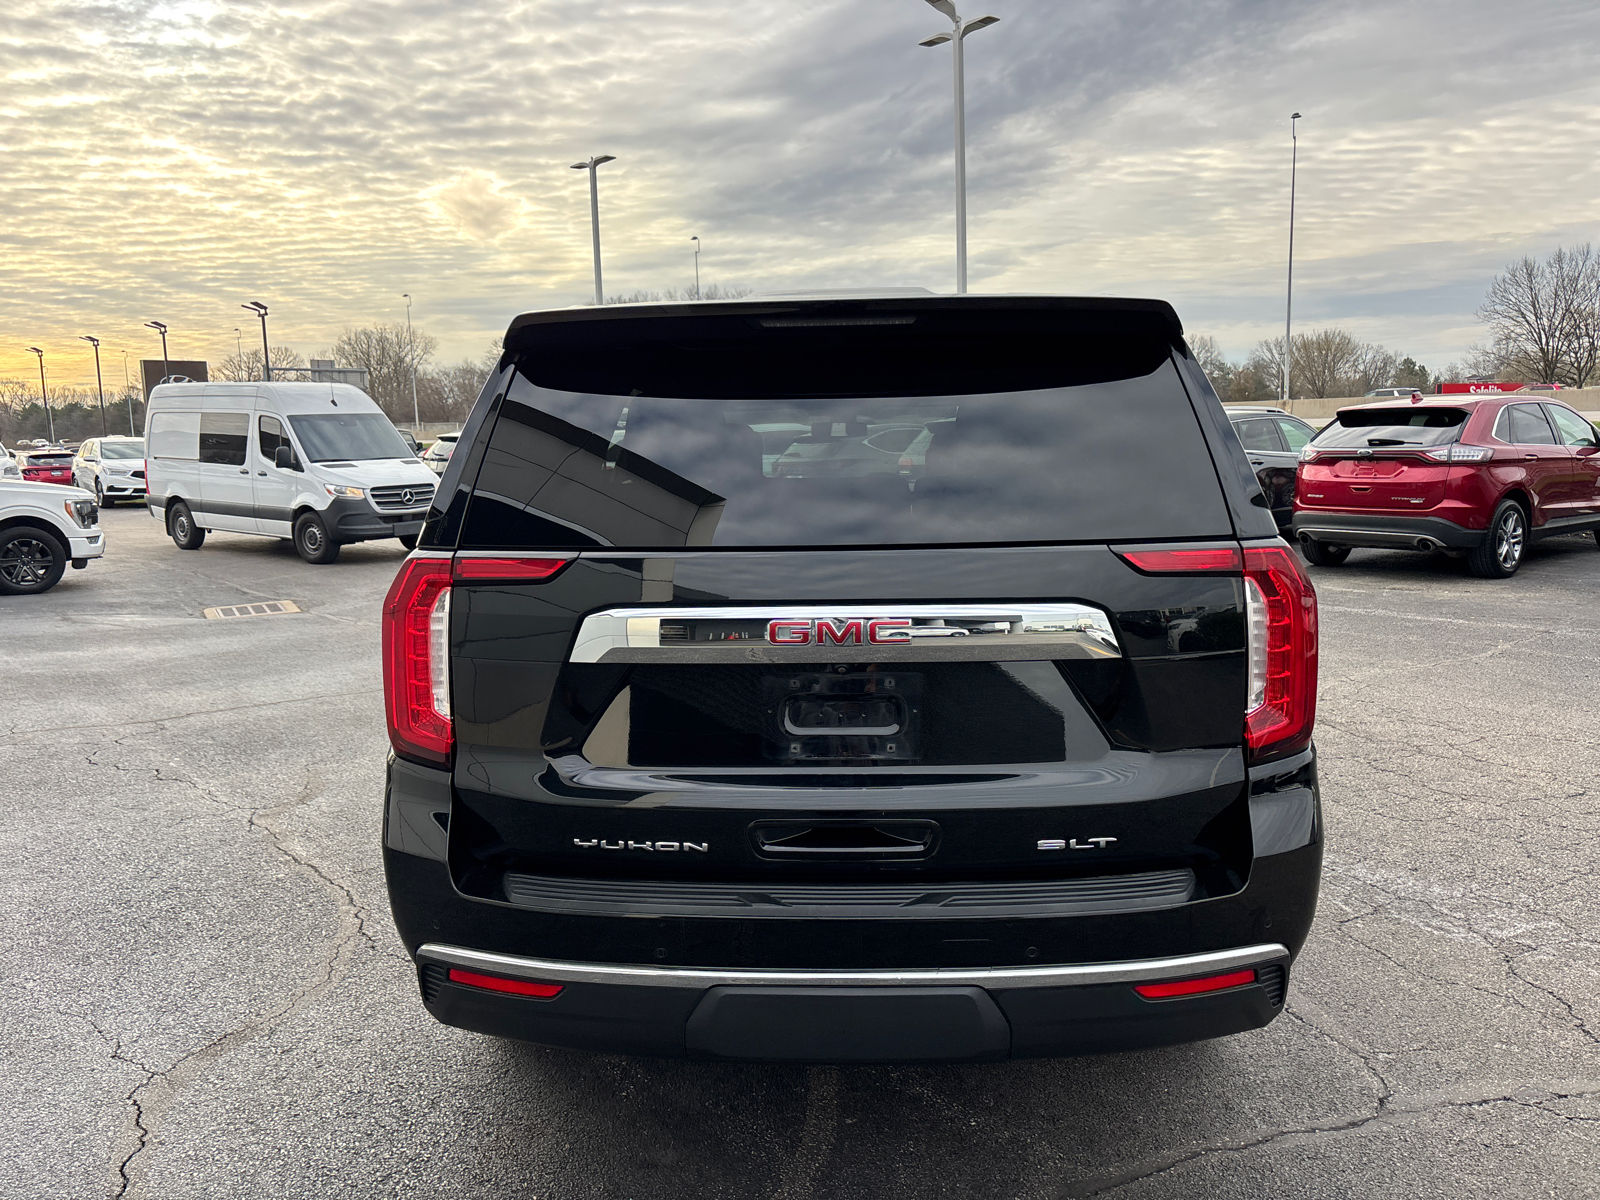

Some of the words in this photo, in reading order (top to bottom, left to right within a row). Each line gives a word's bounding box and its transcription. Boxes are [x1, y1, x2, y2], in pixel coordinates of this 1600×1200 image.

[768, 618, 912, 646] GMC
[573, 838, 709, 852] YUKON
[1037, 837, 1118, 850] SLT
